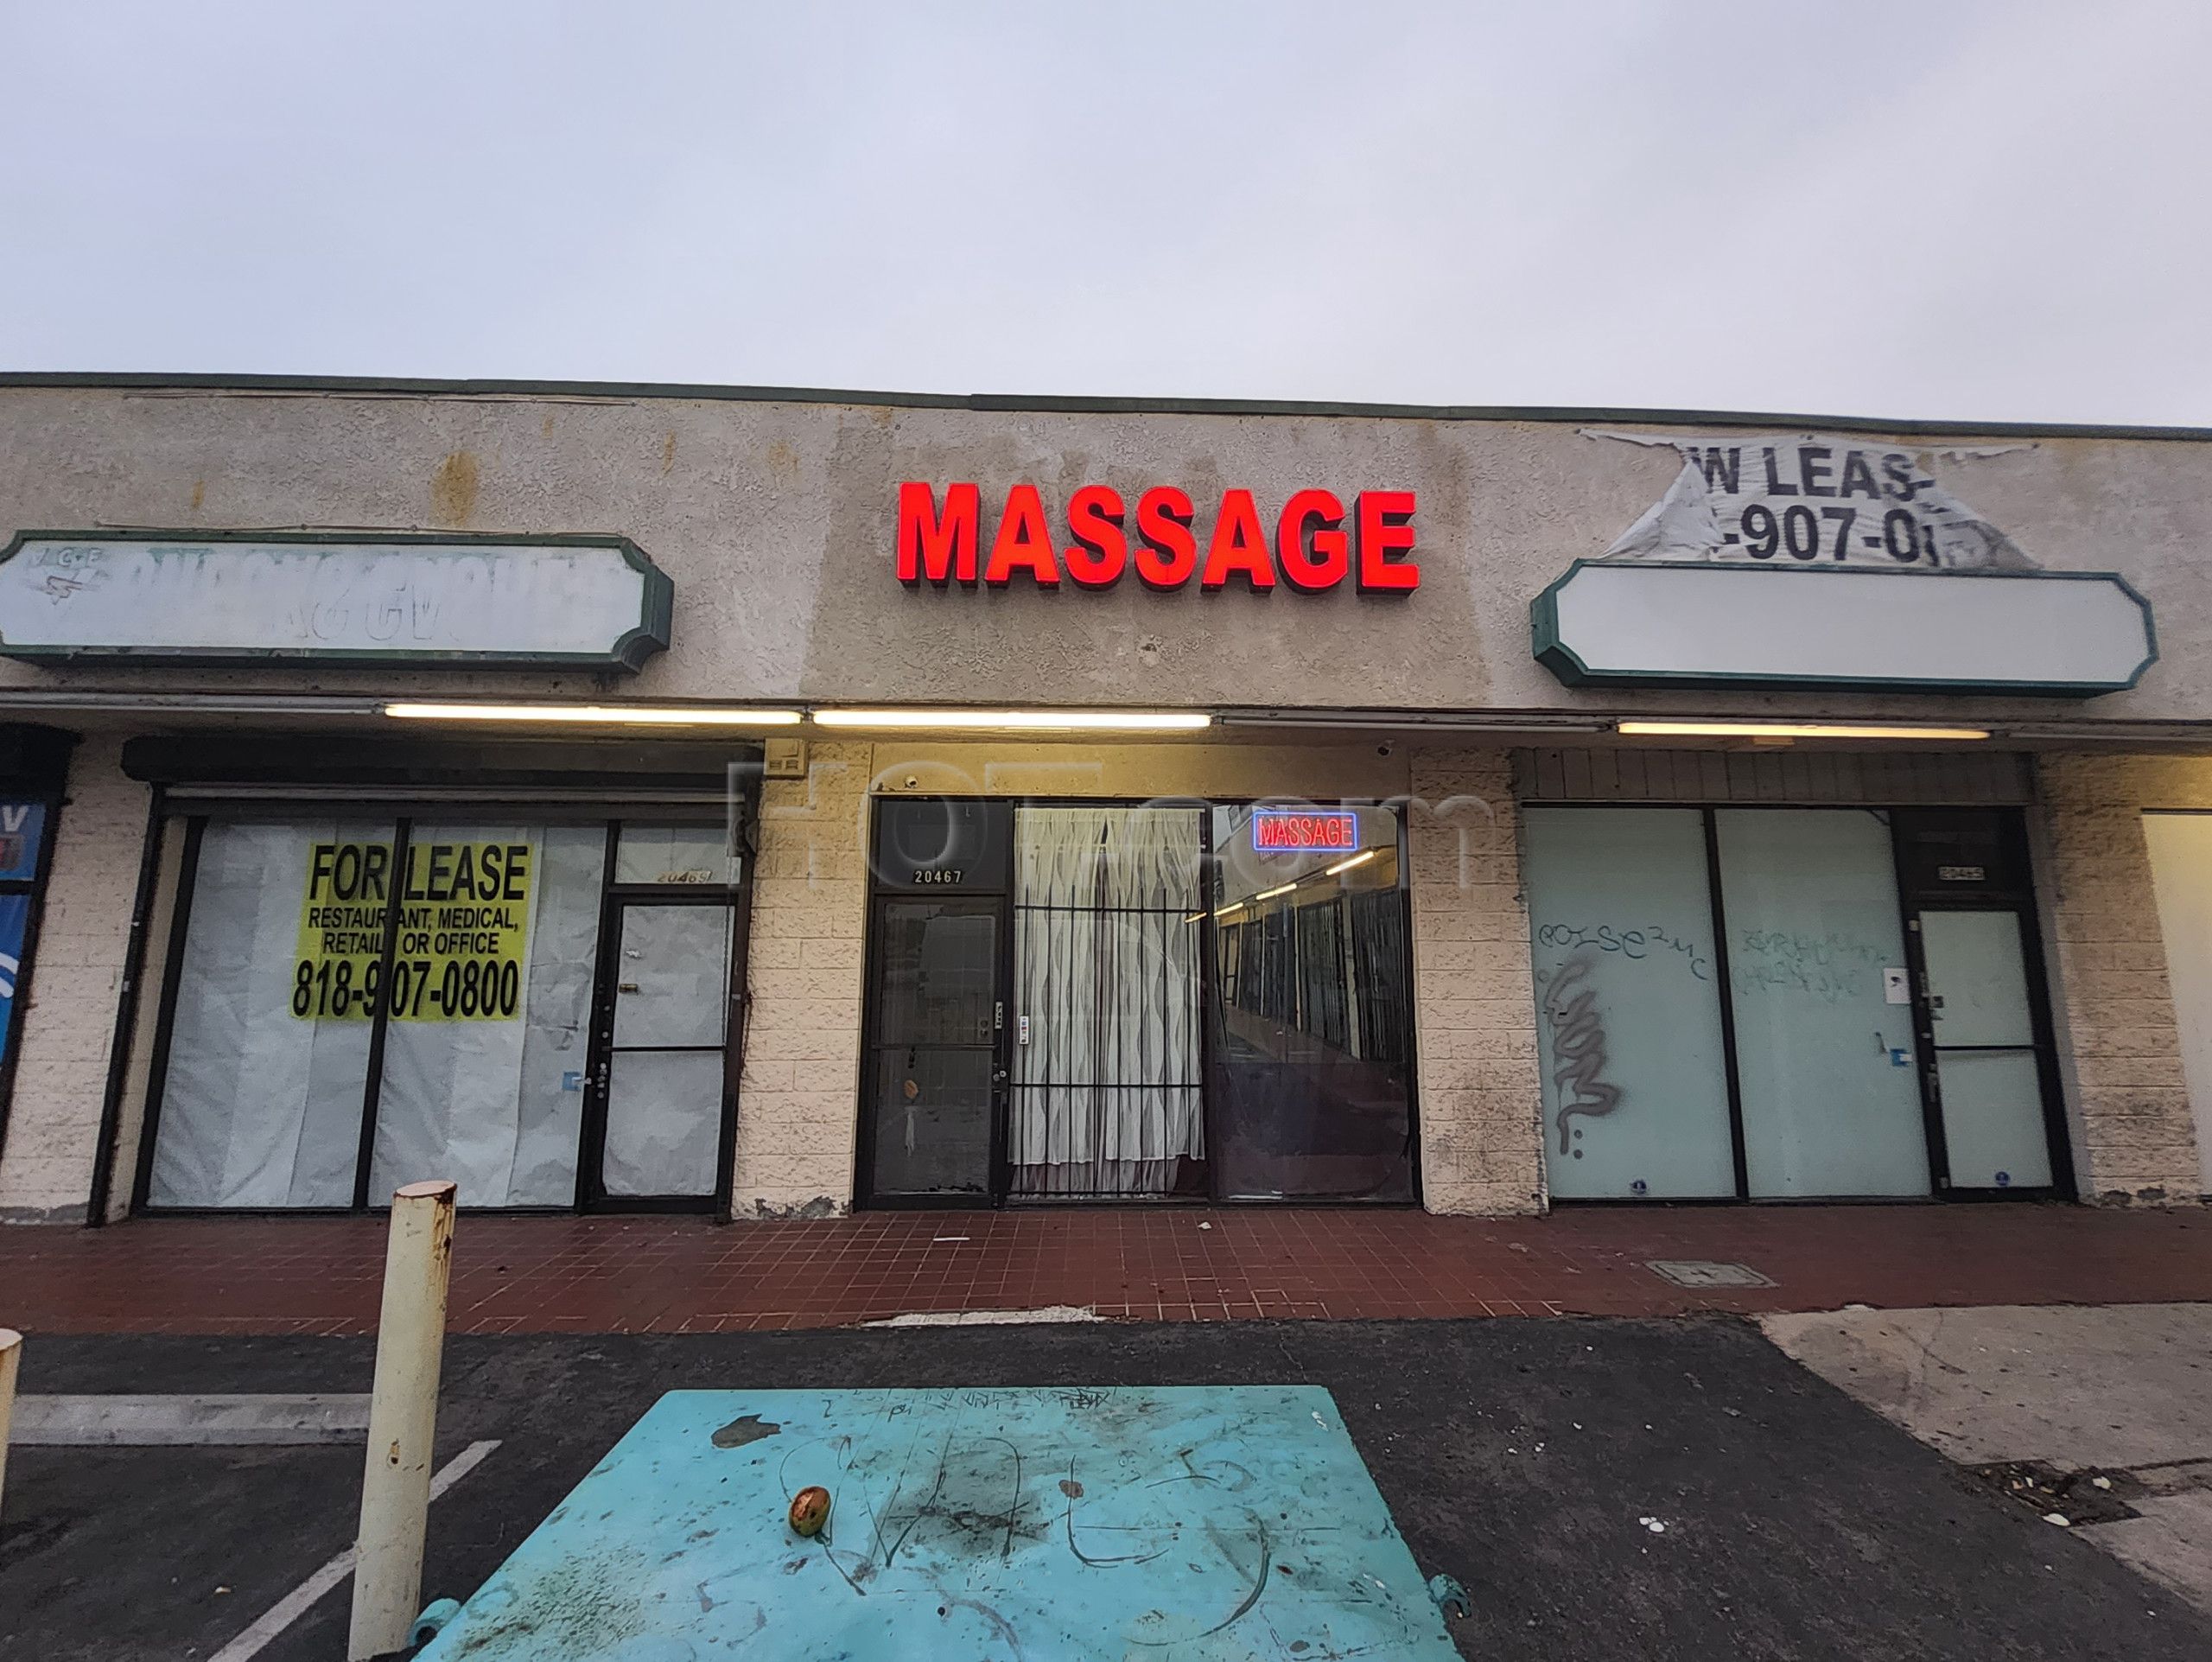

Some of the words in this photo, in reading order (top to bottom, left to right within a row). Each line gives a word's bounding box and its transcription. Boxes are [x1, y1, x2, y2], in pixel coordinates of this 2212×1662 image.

[896, 481, 1420, 595] MASSAGE
[1258, 816, 1354, 846] MASSAGE
[309, 844, 388, 901] FOR
[403, 844, 528, 901] LEASE
[914, 869, 962, 884] 20467
[437, 907, 518, 933] MEDICAL,
[322, 932, 385, 954] RETAIL
[402, 932, 431, 955] OR
[434, 932, 499, 955] OFFICE
[292, 959, 519, 1017] 818-907-0800
